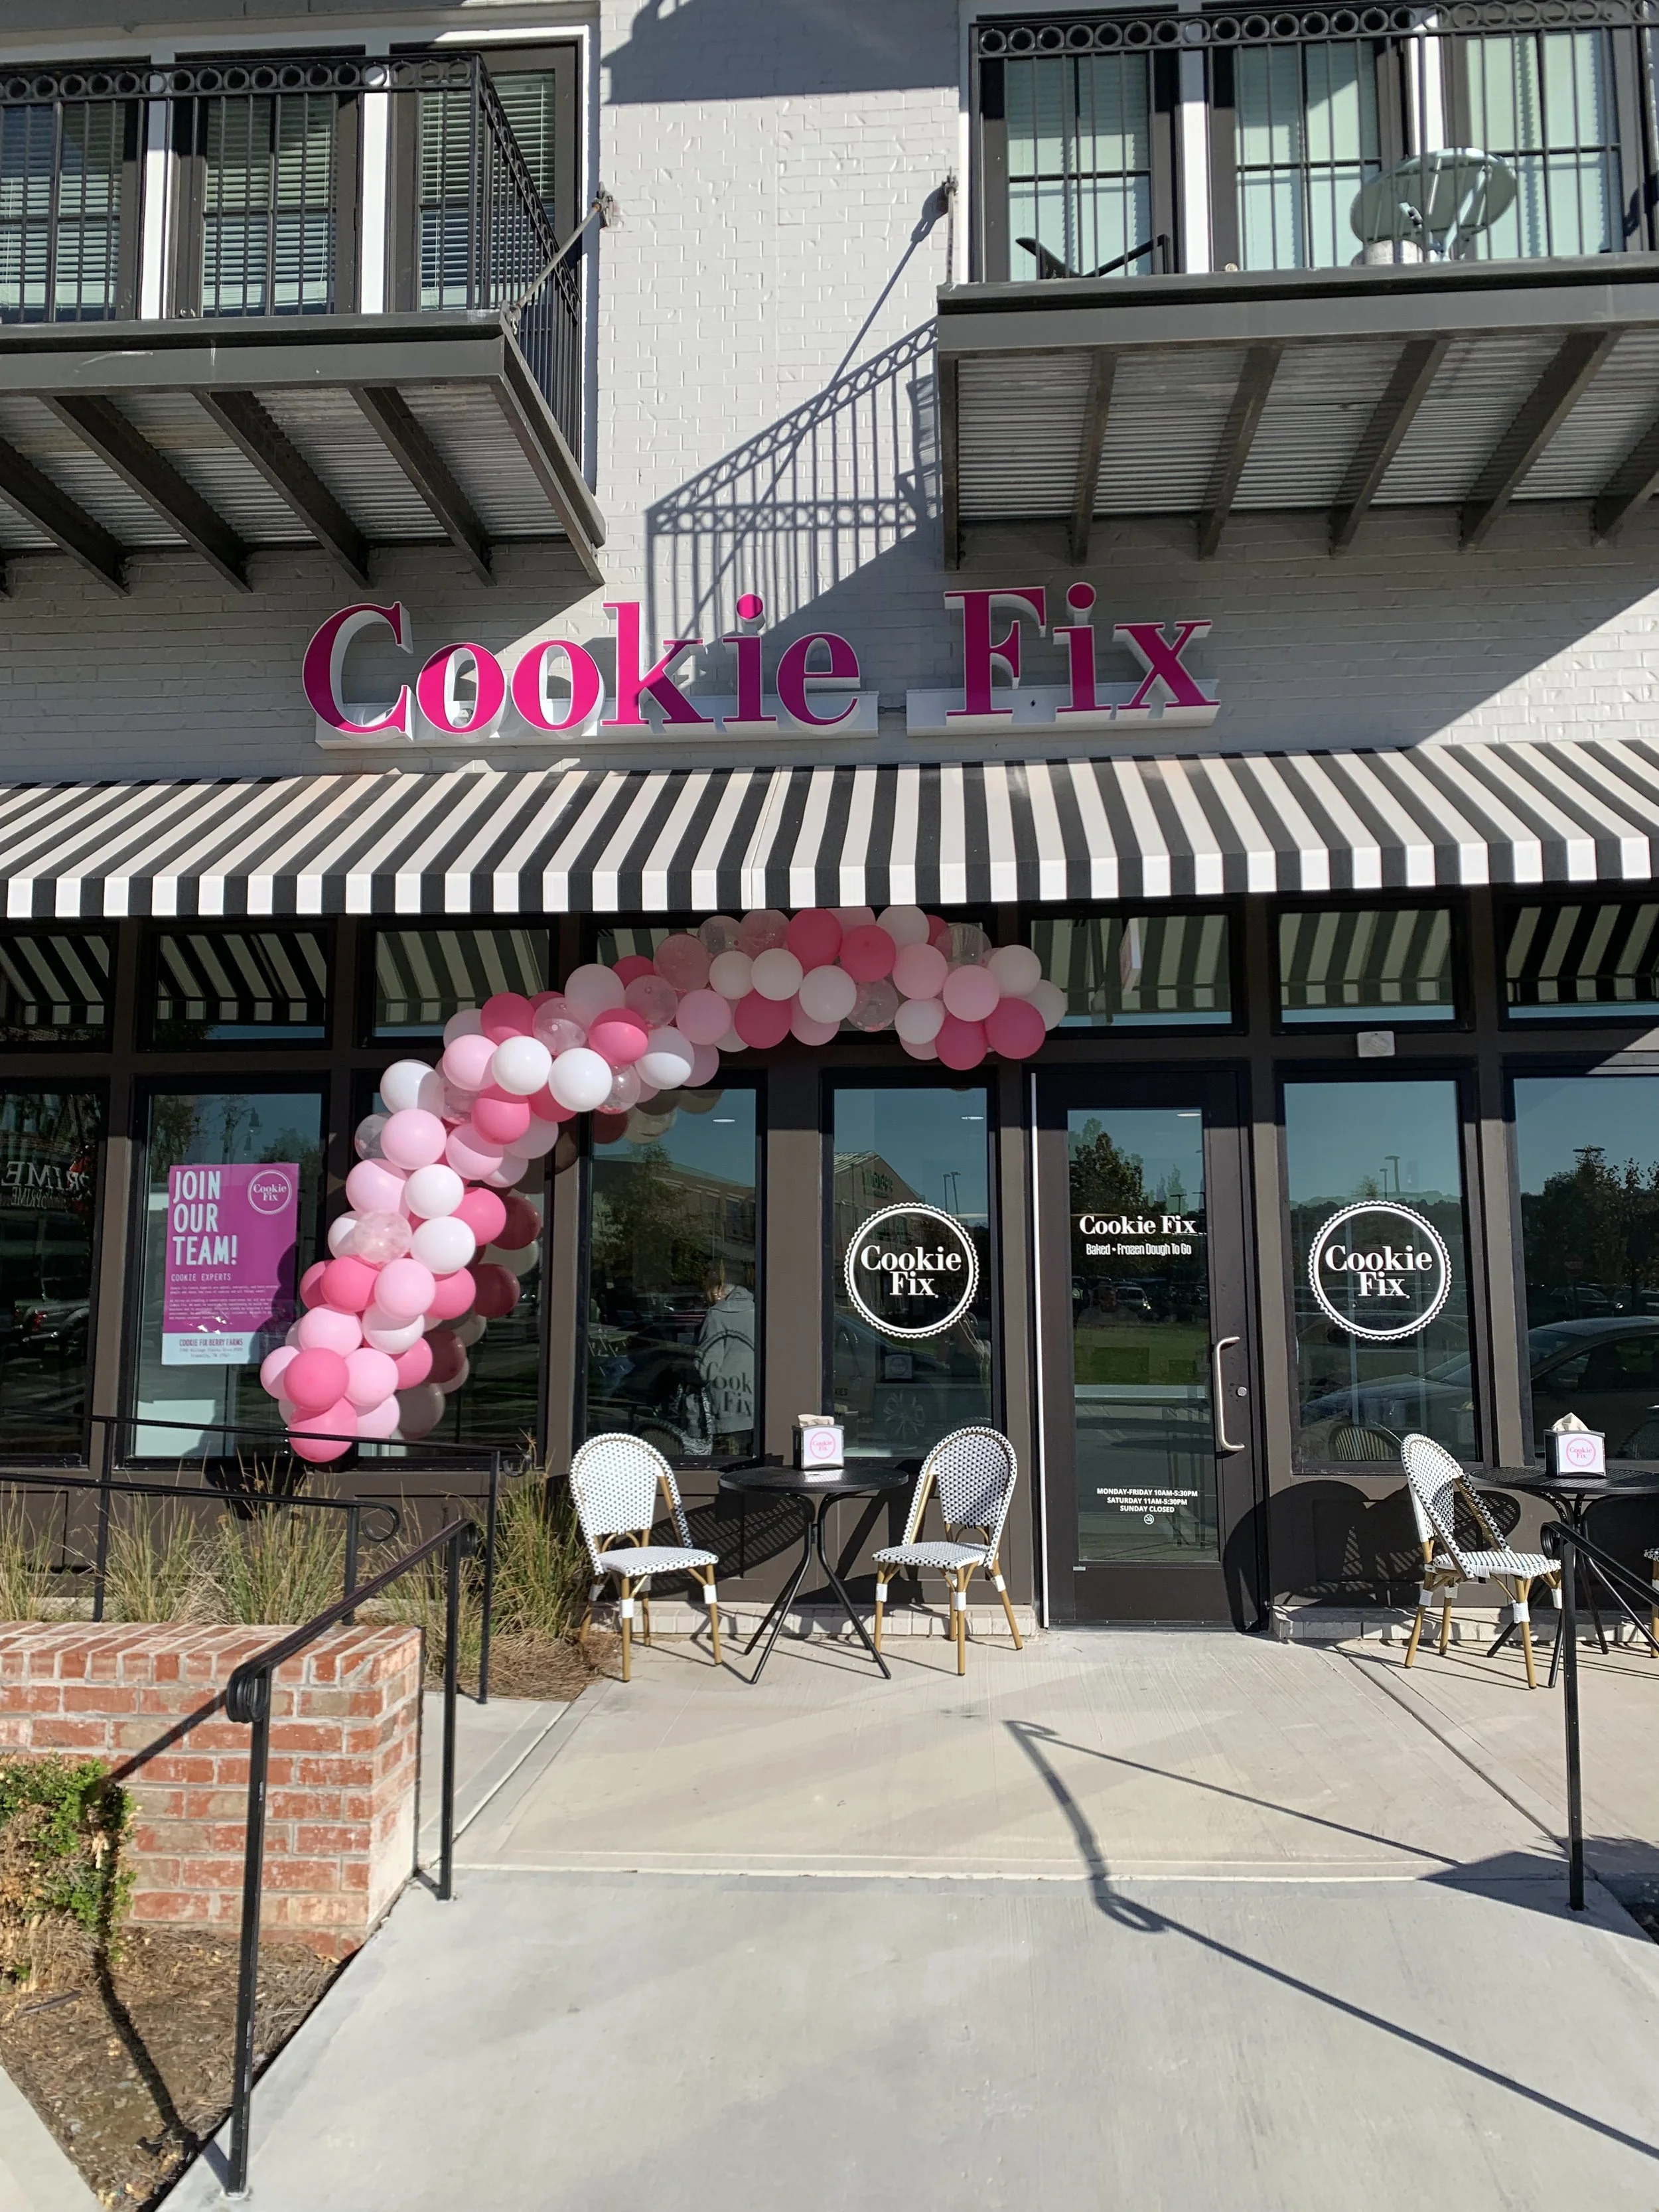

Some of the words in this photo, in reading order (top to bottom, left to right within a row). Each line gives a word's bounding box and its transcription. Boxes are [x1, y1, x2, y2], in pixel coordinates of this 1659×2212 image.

[303, 593, 862, 733] Cookie
[944, 582, 1218, 717] Fix
[173, 1171, 221, 1203] JOIN
[253, 1183, 287, 1193] Cookie
[263, 1192, 279, 1201] Fix
[173, 1203, 218, 1233] OUR
[1079, 1215, 1157, 1235] Cookie
[1160, 1215, 1198, 1234] Fix
[172, 1235, 238, 1266] TEAM!
[861, 1244, 962, 1272] Cookie
[1086, 1243, 1112, 1255] Baked
[1117, 1243, 1145, 1255] Frozen
[1145, 1243, 1171, 1256] Dough
[1171, 1242, 1180, 1255] To
[1181, 1242, 1192, 1255] Go
[1325, 1244, 1433, 1272] Cookie
[171, 1273, 196, 1282] COOKIE
[201, 1272, 232, 1282] EXPERTS
[889, 1270, 936, 1296] Fix
[1357, 1270, 1407, 1297] Fix
[226, 1338, 244, 1347] FARMS
[1096, 1487, 1153, 1496] MONDAY-FRIDAY
